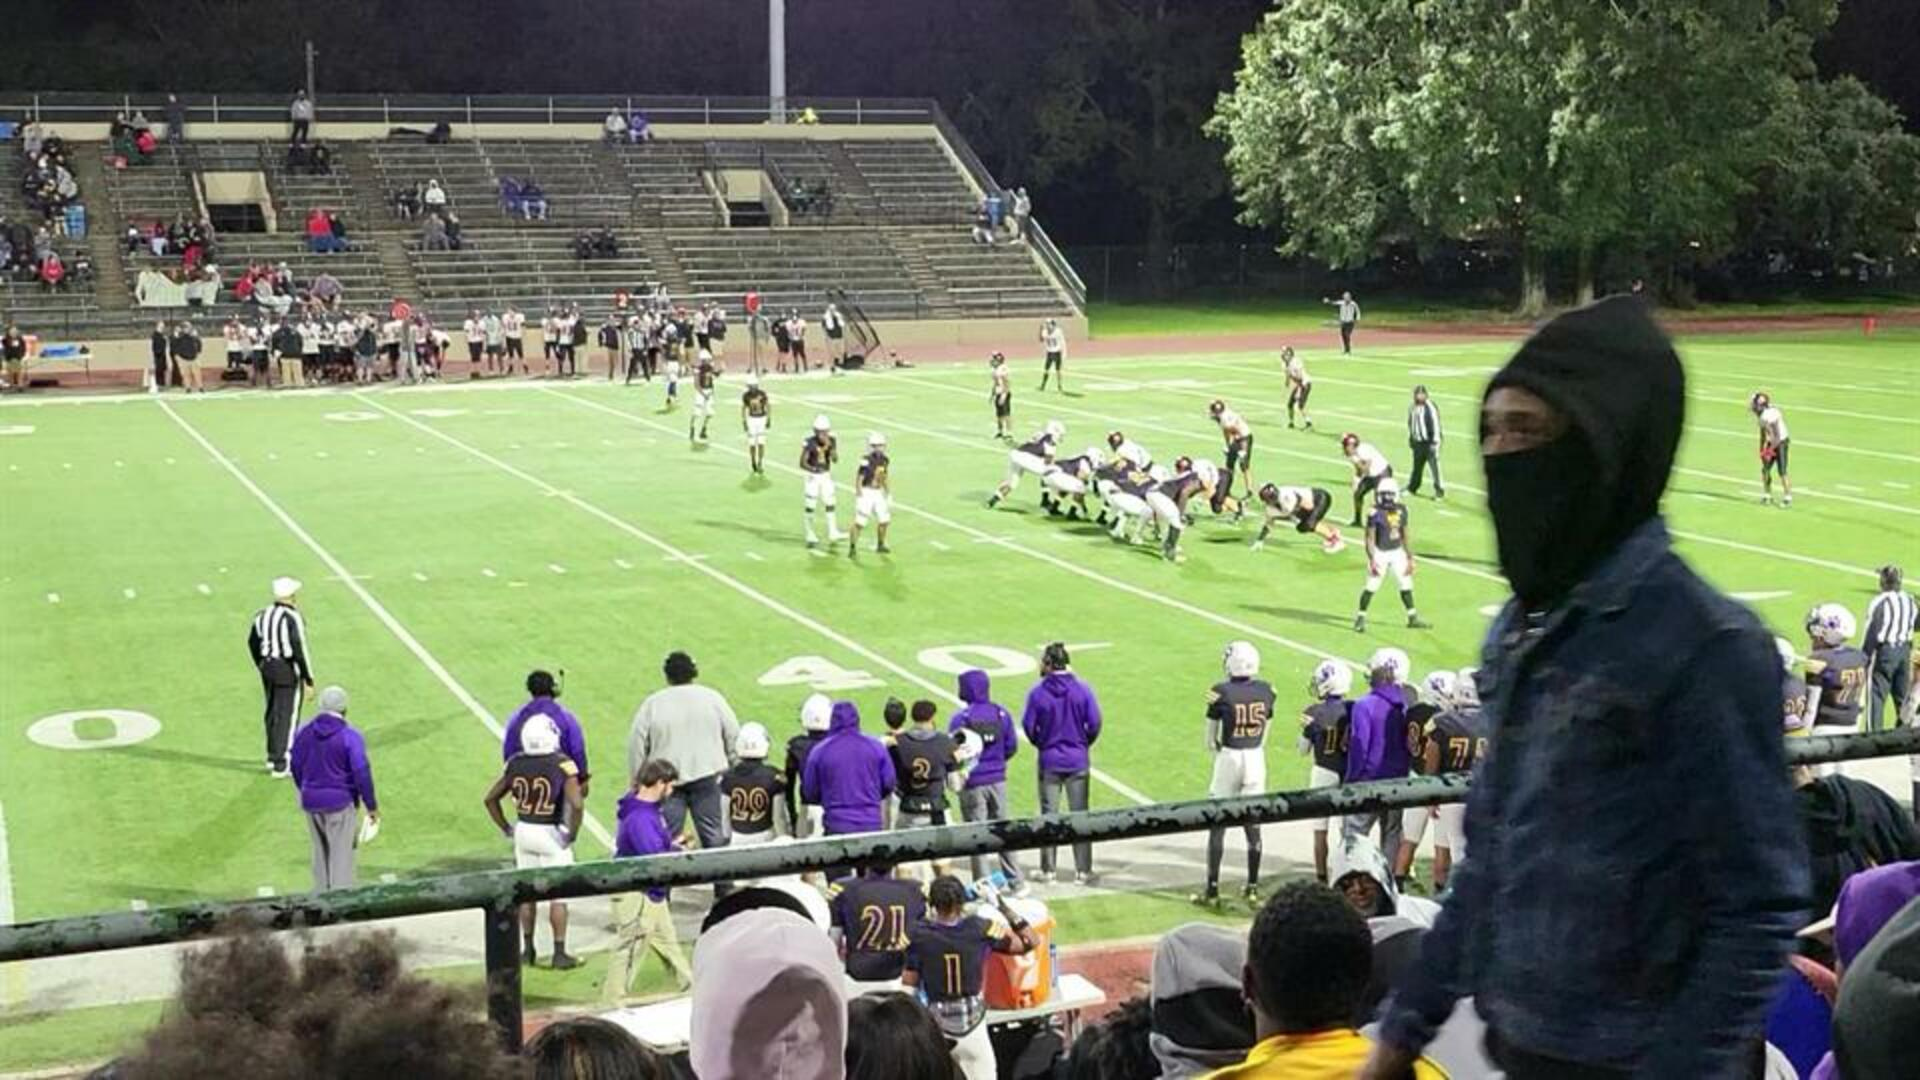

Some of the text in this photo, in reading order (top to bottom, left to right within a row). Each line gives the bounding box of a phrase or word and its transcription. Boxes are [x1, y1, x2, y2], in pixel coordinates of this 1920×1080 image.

[1233, 702, 1267, 738] 15
[512, 776, 556, 815] 22
[856, 904, 907, 952] 21
[943, 952, 961, 995] 1
